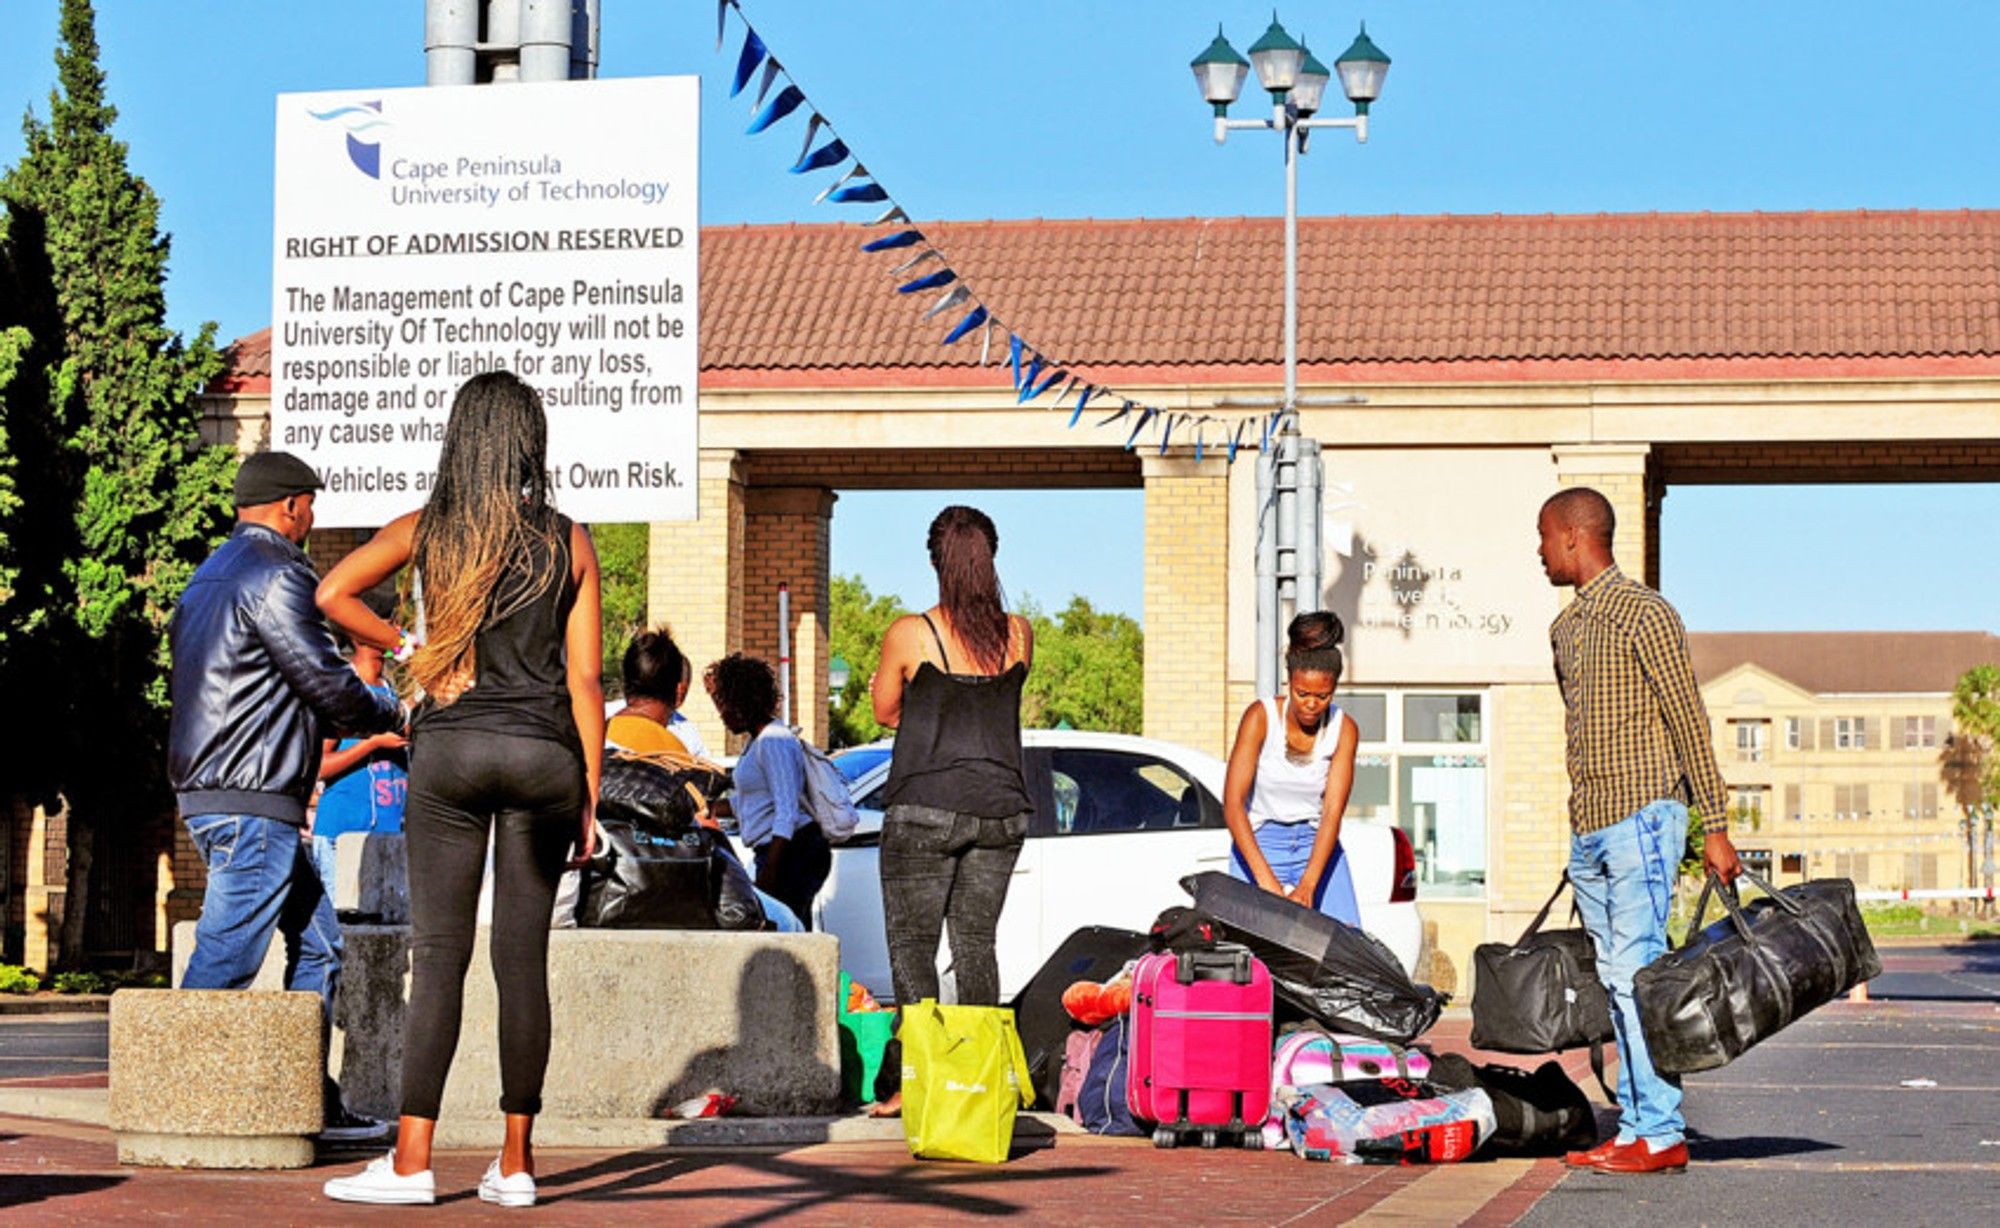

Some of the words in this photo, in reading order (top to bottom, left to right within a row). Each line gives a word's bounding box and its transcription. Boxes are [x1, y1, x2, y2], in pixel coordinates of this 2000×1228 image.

[391, 159, 449, 183] Cape
[456, 155, 562, 177] Peninsula
[391, 182, 500, 207] University
[508, 181, 530, 202] of
[538, 178, 670, 204] Technology
[286, 236, 360, 258] RIGHT
[366, 234, 399, 255] OF
[406, 230, 550, 254] ADMISSION
[558, 227, 684, 250] RESERVED
[286, 287, 325, 312] The
[333, 284, 473, 316] Management
[480, 283, 503, 308] of
[508, 281, 565, 312] Cape
[573, 279, 684, 306] Peninsula
[284, 320, 393, 350] University
[401, 317, 426, 344] Of
[434, 315, 561, 348] Technology
[569, 315, 606, 341] will
[613, 315, 650, 340] not
[657, 313, 684, 339] be
[283, 352, 411, 385] responsible
[418, 357, 440, 378] or
[447, 349, 506, 377] liable
[513, 349, 544, 376] for
[552, 354, 592, 381] any
[599, 349, 652, 377] loss,
[284, 387, 369, 416] damage
[376, 385, 417, 409] and
[424, 388, 446, 408] or
[536, 380, 622, 412] esulting
[631, 382, 682, 408] from
[284, 424, 323, 450] any
[330, 422, 394, 444] cause
[317, 466, 407, 492] Vehicles
[415, 470, 437, 491] ar
[569, 464, 619, 488] Own
[628, 462, 683, 488] Risk.
